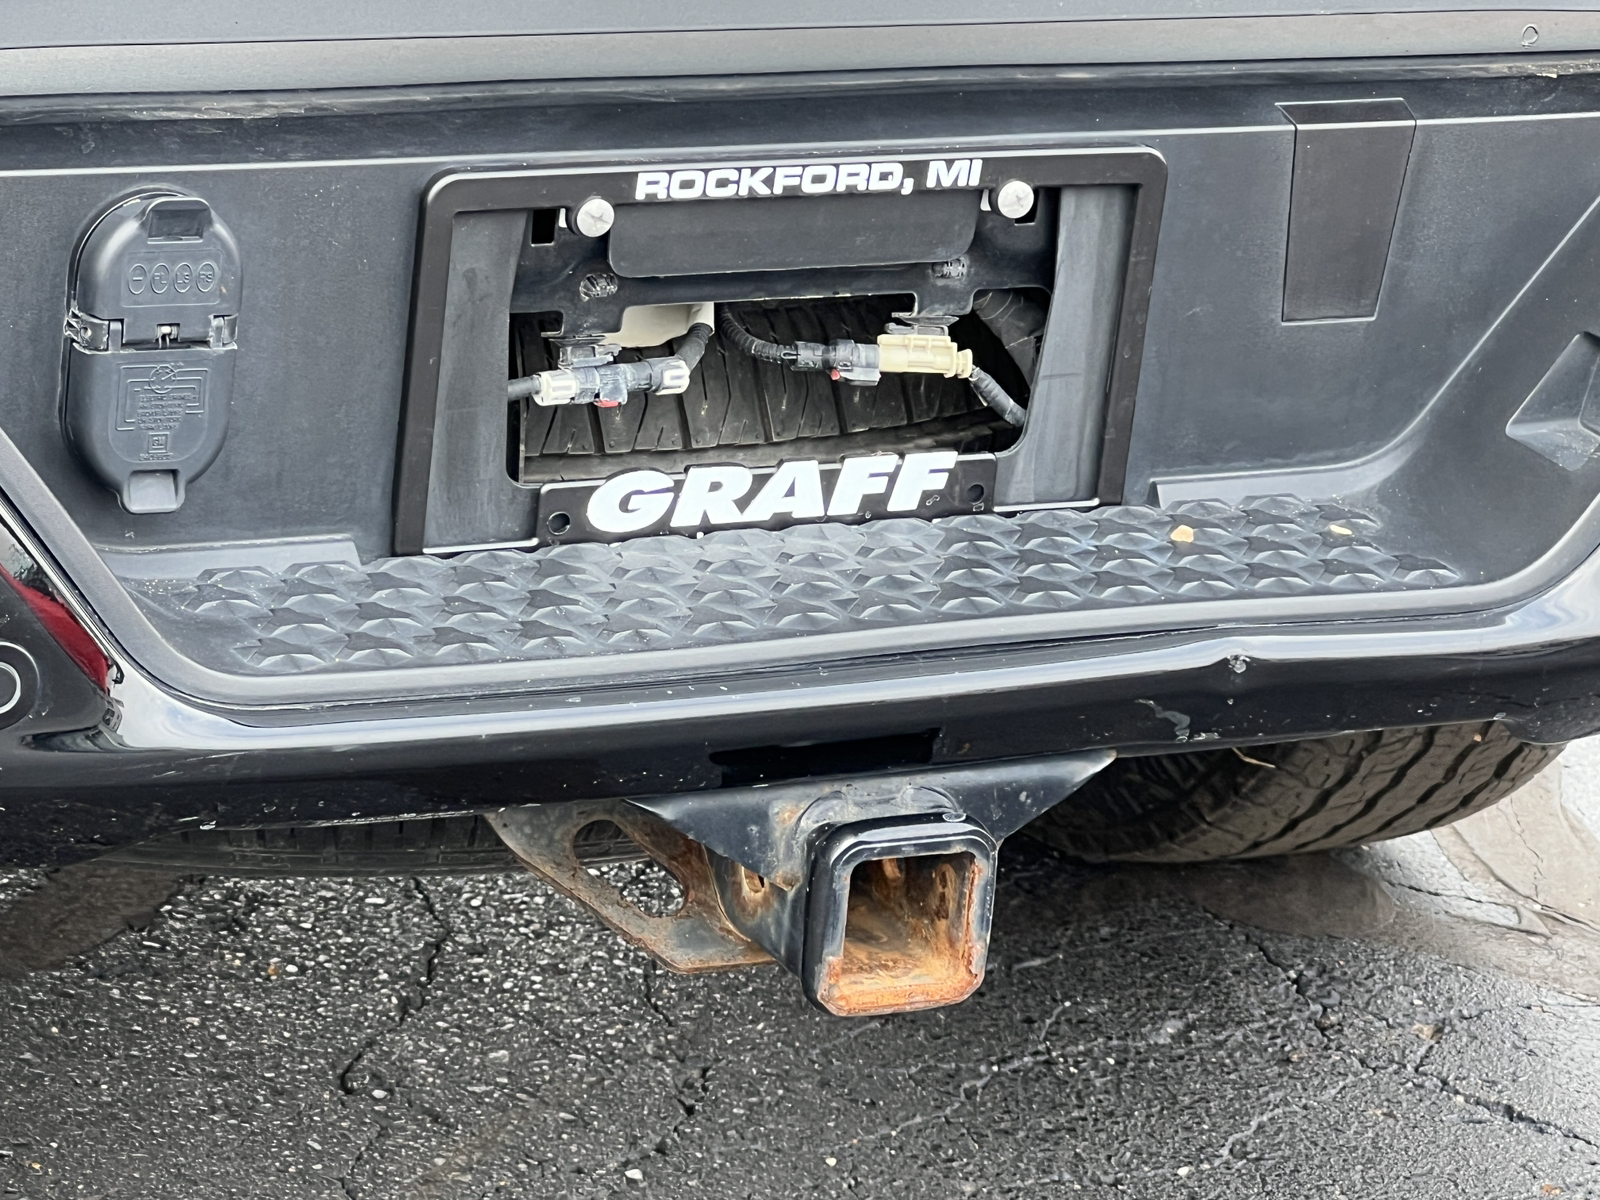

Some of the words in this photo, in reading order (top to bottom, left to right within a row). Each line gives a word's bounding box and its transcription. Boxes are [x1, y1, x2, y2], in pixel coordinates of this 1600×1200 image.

[635, 161, 913, 200] ROCKFORD,
[927, 158, 983, 188] MI
[586, 450, 957, 533] GRAFF
